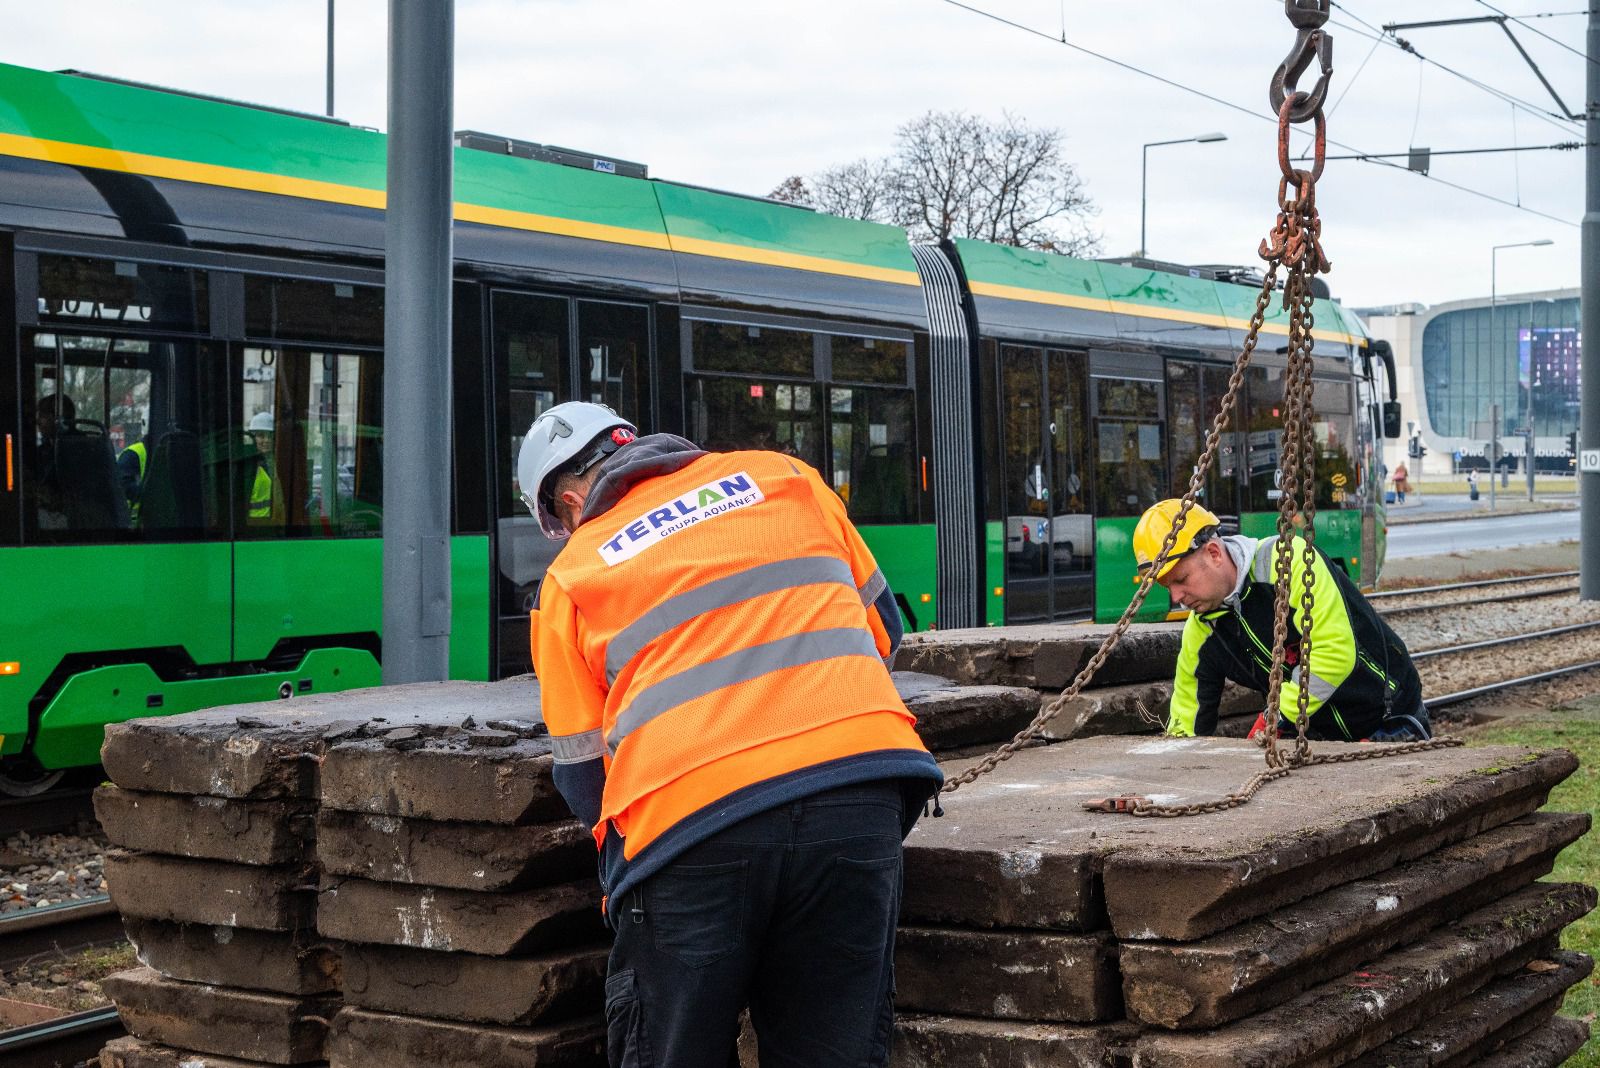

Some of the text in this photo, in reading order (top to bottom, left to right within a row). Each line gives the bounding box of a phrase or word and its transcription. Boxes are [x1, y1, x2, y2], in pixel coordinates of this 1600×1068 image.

[1583, 455, 1598, 467] 10
[602, 475, 752, 553] TERLAN
[660, 492, 757, 537] GRUPA AQUANET
